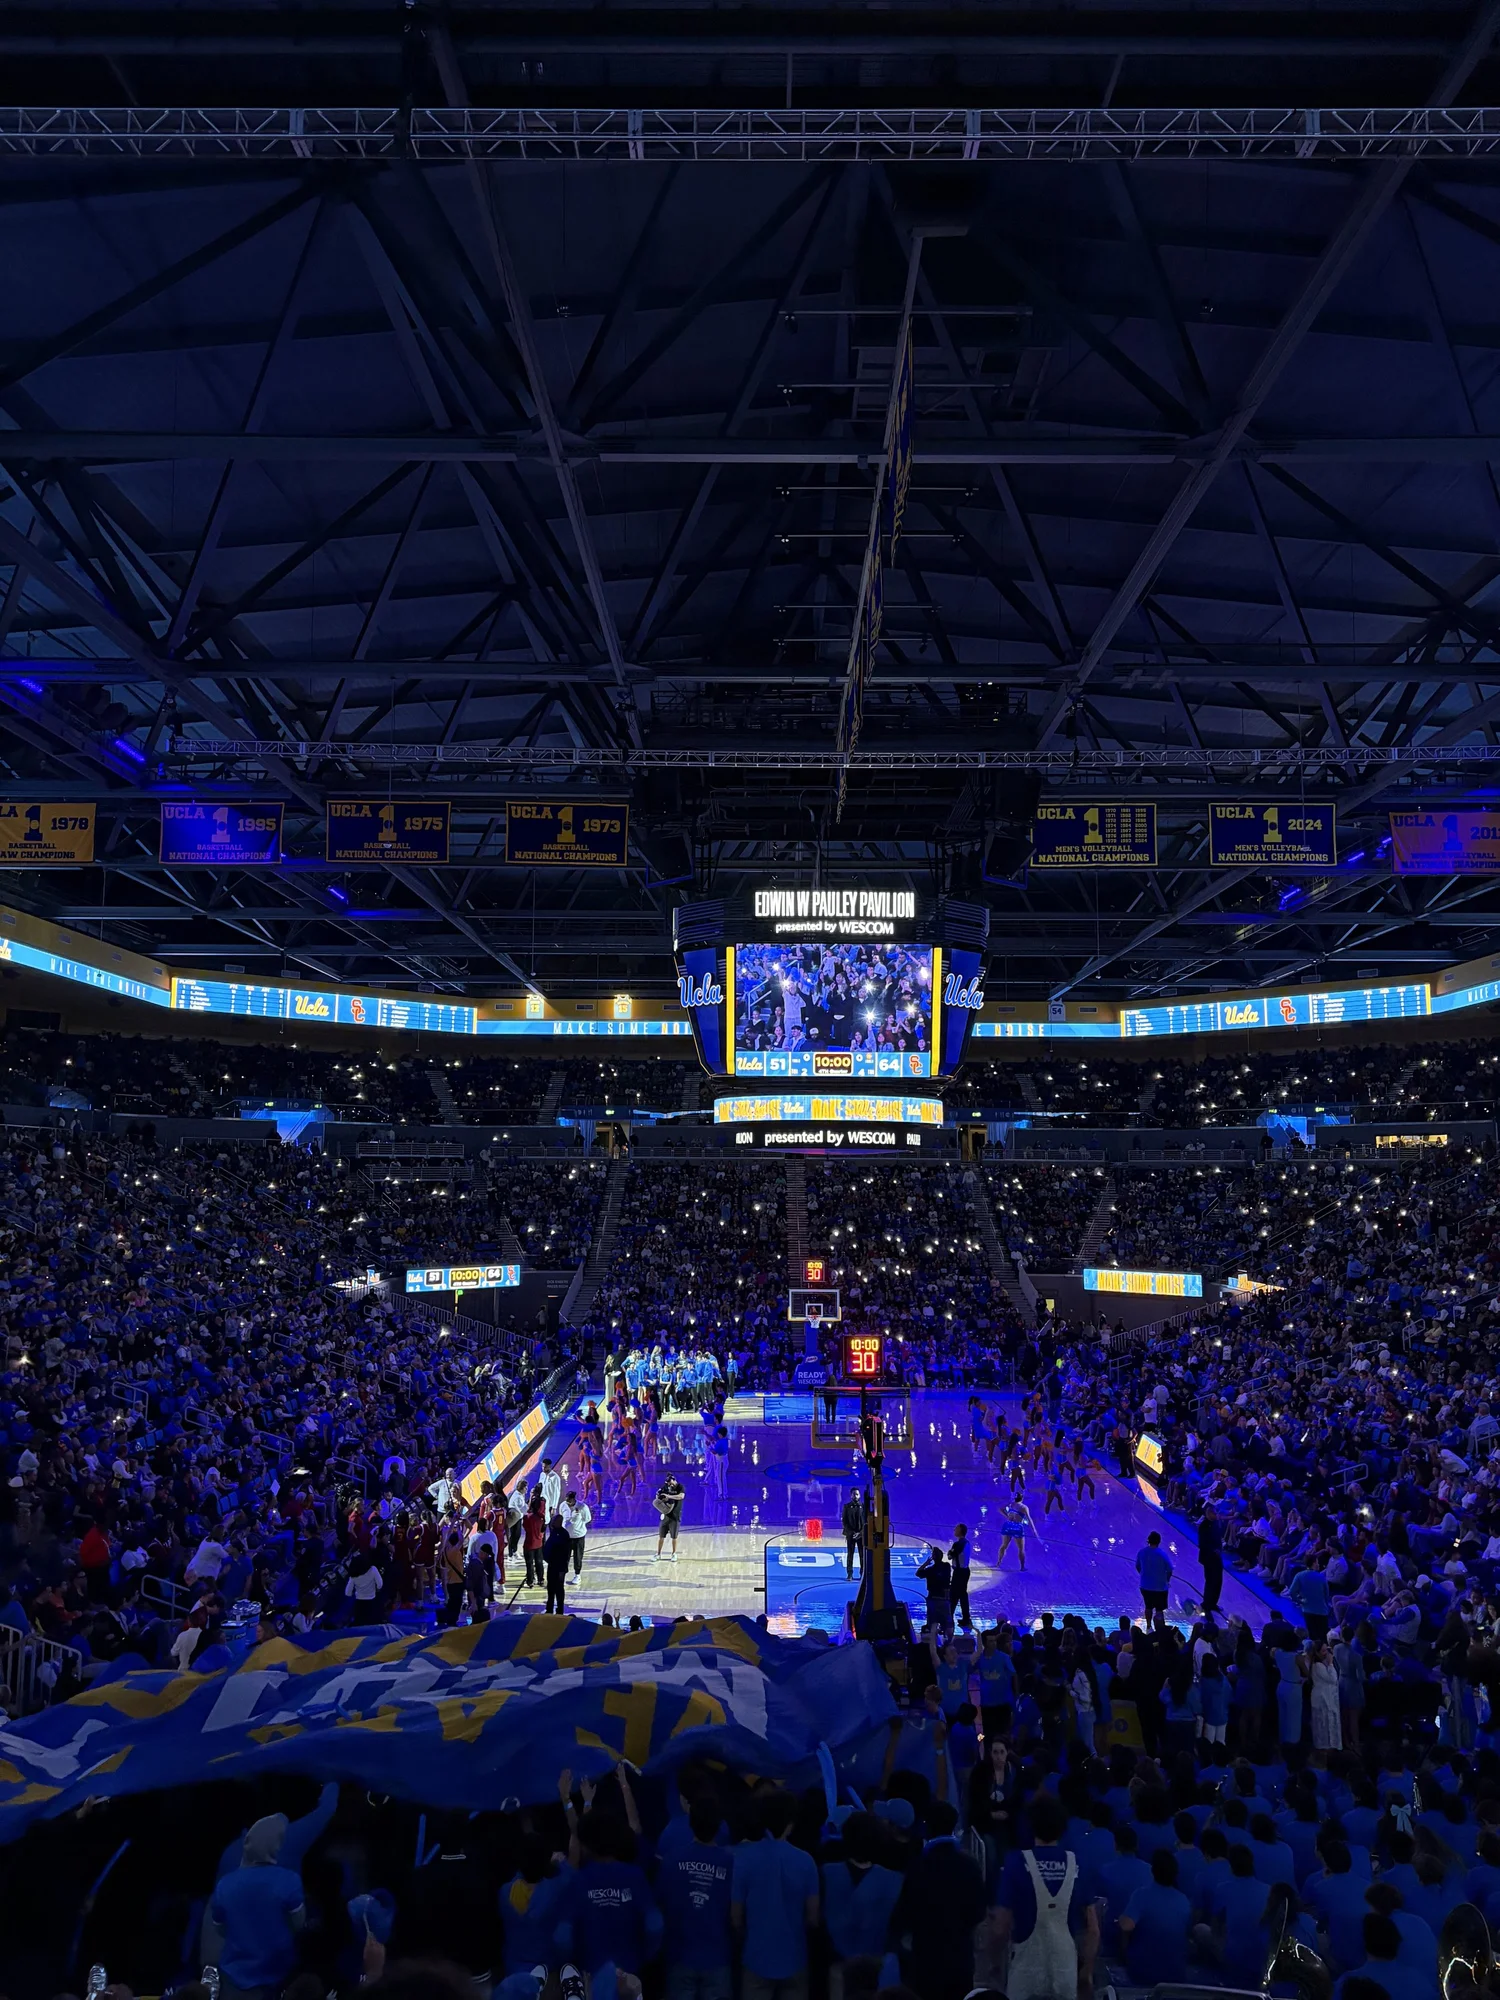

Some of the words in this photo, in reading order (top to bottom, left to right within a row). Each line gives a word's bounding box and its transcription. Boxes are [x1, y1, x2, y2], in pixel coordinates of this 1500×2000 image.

[164, 806, 206, 819] UCLA
[330, 804, 372, 817] UCLA
[511, 805, 553, 819] UCLA
[1037, 807, 1077, 820] UCLA
[1215, 806, 1256, 819] UCLA
[51, 817, 89, 831] 1978
[237, 818, 277, 832] 1995
[404, 817, 443, 831] 1975
[583, 818, 621, 833] 1973
[1287, 818, 1323, 831] 2024
[1392, 815, 1436, 827] UCLA
[197, 843, 243, 851] BASKETBALL
[542, 843, 590, 851] BASKETBALL
[1055, 845, 1080, 853] MEN'S
[1234, 844, 1259, 852] MEN'S
[21, 851, 76, 859] CHAMPIONS
[169, 851, 216, 860] NATIONAL
[217, 851, 271, 860] CHAMPIONS
[335, 850, 381, 859] NATIONAL
[384, 850, 438, 859] CHAMPIONS
[514, 851, 562, 860] NATIONAL
[563, 852, 617, 861] CHAMPIONS
[1038, 854, 1090, 863] NATIONAL
[1091, 853, 1150, 862] CHAMPIONS
[1217, 852, 1268, 861] NATIONAL
[1270, 853, 1329, 862] CHAMPIONS
[755, 891, 795, 917] EDWIN
[797, 891, 810, 917] W
[812, 891, 858, 917] PAULEY
[860, 891, 915, 918] PAVILION
[775, 921, 823, 934] presented
[824, 921, 837, 933] by
[839, 921, 894, 935] WESCOM
[50, 957, 79, 978] MAKE
[86, 969, 113, 988] SOME
[677, 972, 724, 1008] Ucla
[945, 973, 985, 1010] Ucla
[1468, 986, 1489, 1003] MAKE
[294, 995, 330, 1016] Ucla
[1052, 1007, 1062, 1015] 54
[1224, 1004, 1260, 1025] Ucla
[553, 1022, 595, 1035] MAKE
[607, 1022, 649, 1035] SOME
[994, 1023, 1045, 1037] NOISE
[736, 1056, 764, 1071] Ucla
[770, 1057, 786, 1071] 51
[803, 1053, 811, 1062] 0
[815, 1056, 851, 1068] 10:00
[855, 1053, 864, 1062] 0
[879, 1058, 900, 1071] 64
[764, 1130, 824, 1146] presented
[826, 1130, 844, 1147] by
[847, 1131, 896, 1145] WESCOM
[428, 1272, 440, 1282] 51
[451, 1270, 479, 1280] 10:00
[487, 1269, 500, 1279] 64
[807, 1269, 821, 1280] 30
[1097, 1271, 1123, 1292] MAKE
[1125, 1272, 1153, 1294] SOME
[1155, 1273, 1185, 1297] NOISE
[850, 1339, 879, 1352] 10:00
[852, 1352, 875, 1372] 30
[798, 1371, 823, 1379] READY
[678, 1861, 715, 1874] WESCOM
[587, 1887, 621, 1899] WESCOM
